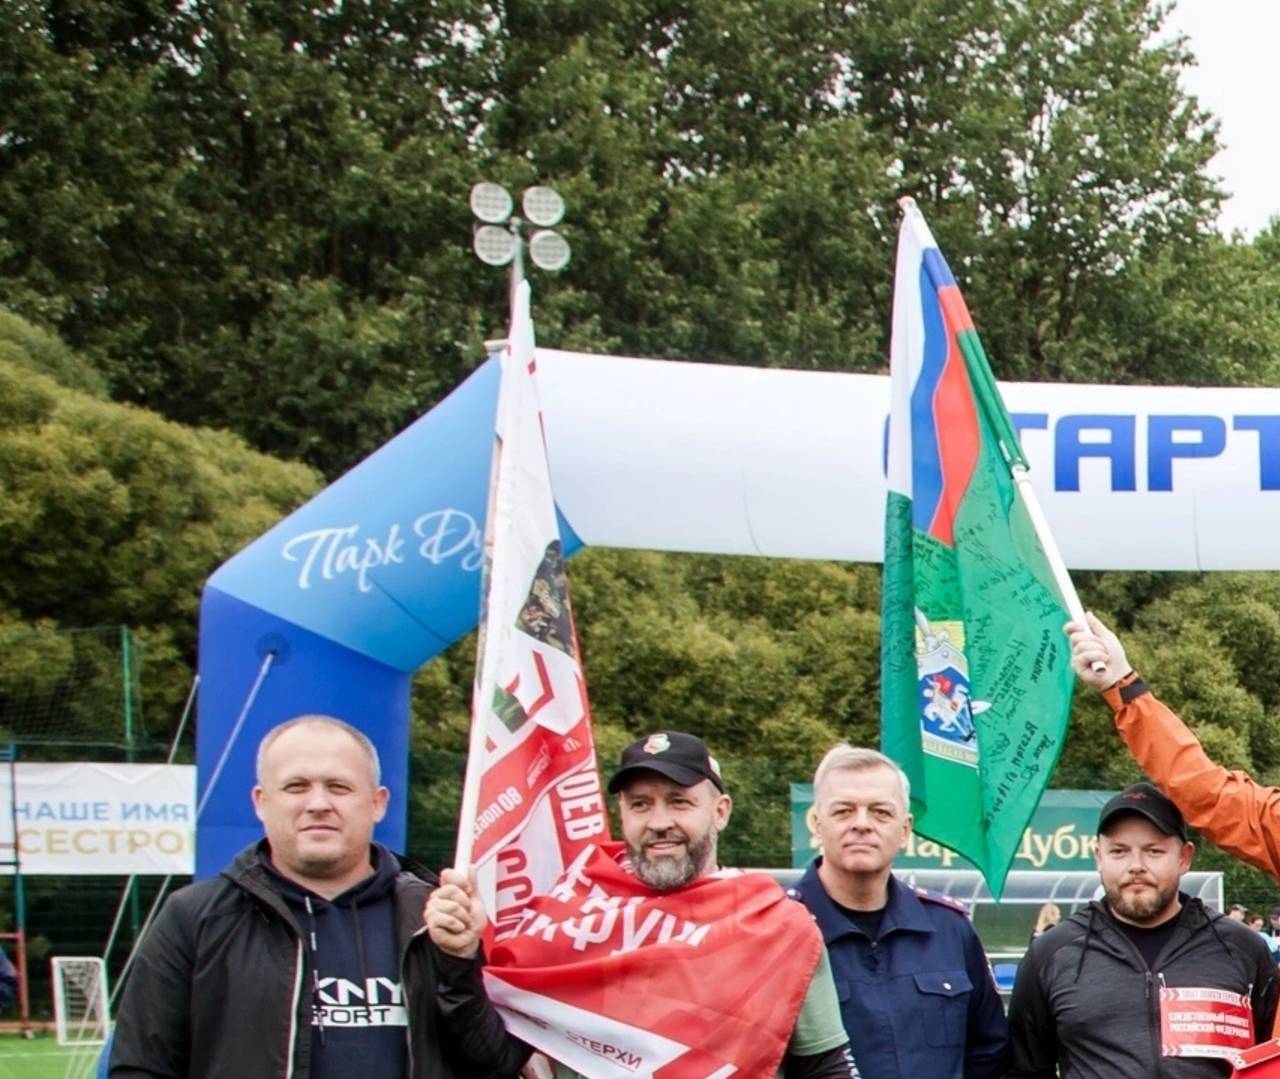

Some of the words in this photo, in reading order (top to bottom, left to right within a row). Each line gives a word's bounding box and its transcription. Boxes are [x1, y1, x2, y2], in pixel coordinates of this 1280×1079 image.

[282, 524, 404, 592] Парк
[14, 801, 110, 821] НАШЕ
[121, 802, 189, 822] ИМЯ
[556, 765, 604, 840] ОЕВ
[16, 828, 195, 855] СЕСТРО
